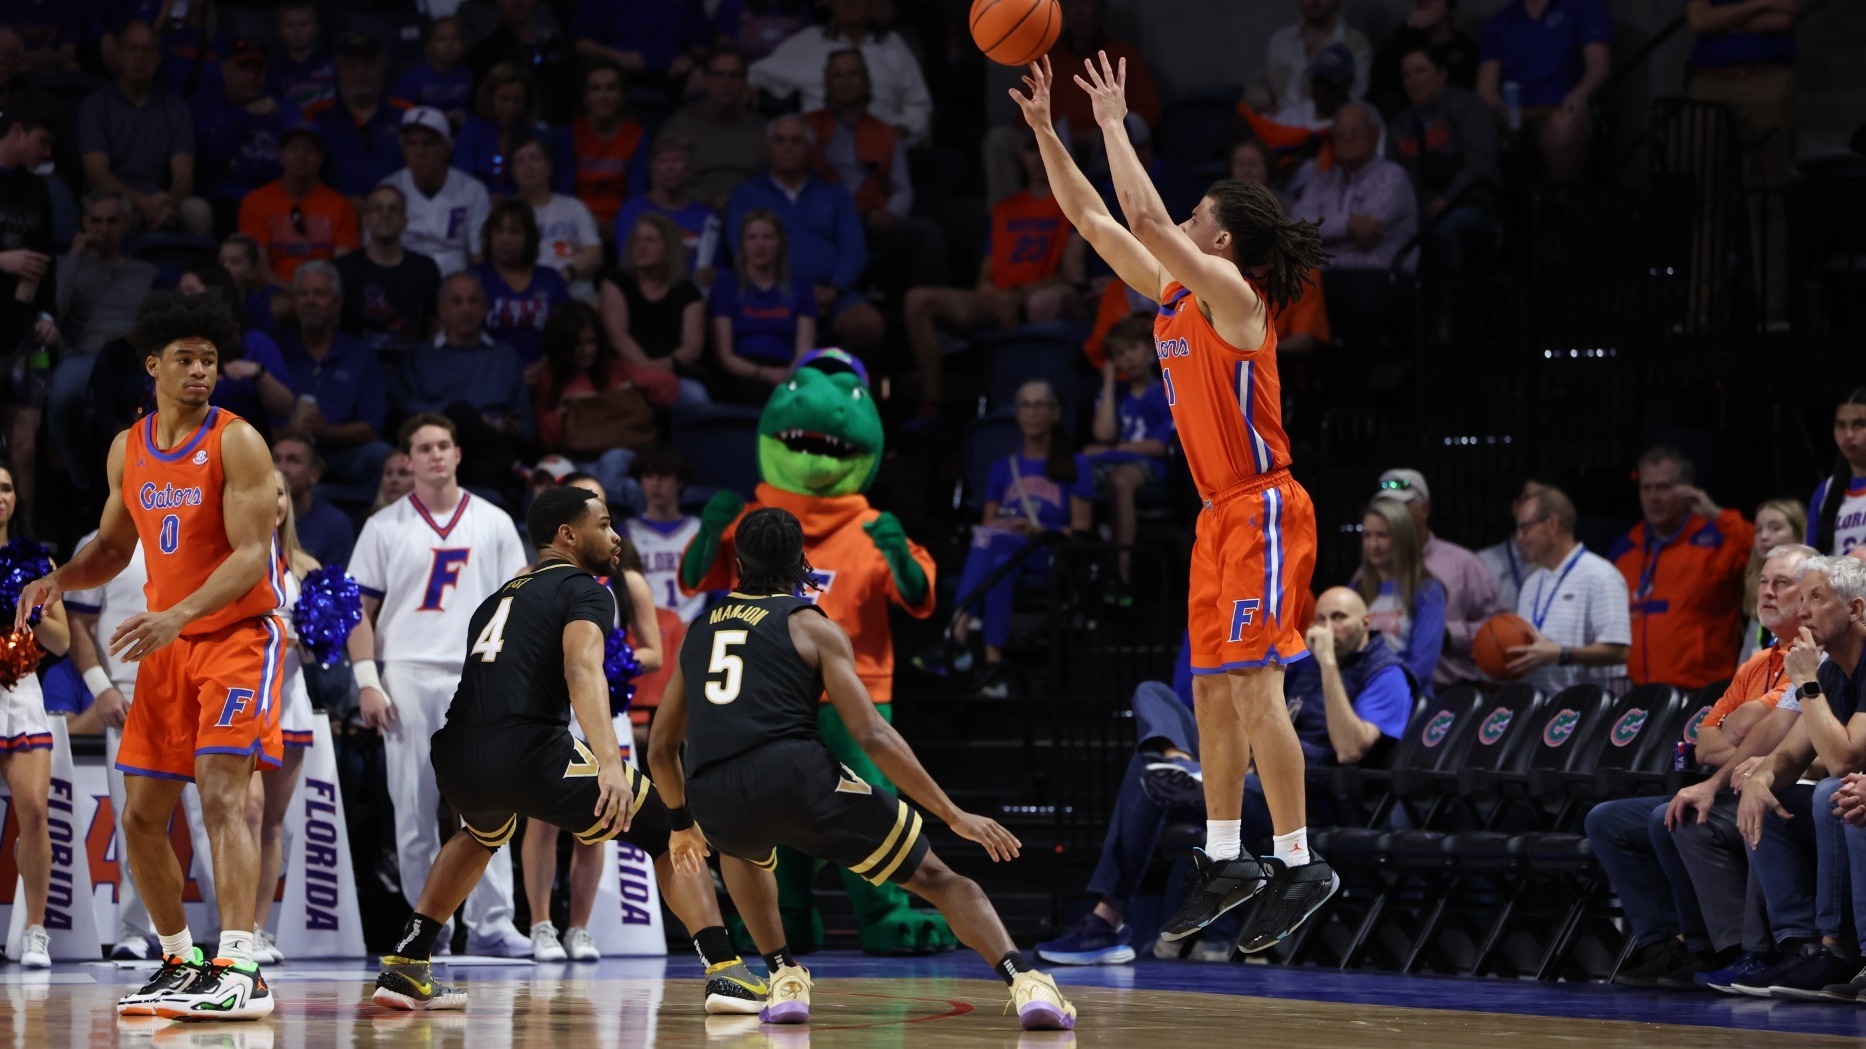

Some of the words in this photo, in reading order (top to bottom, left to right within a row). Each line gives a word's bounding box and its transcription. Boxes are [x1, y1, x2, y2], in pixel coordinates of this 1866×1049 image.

[447, 207, 467, 239] F
[1163, 367, 1176, 407] 1
[140, 482, 202, 510] Gators
[160, 514, 180, 554] 0
[415, 547, 471, 613] F
[665, 579, 678, 607] 1
[470, 596, 514, 663] 4
[709, 604, 770, 627] MANJON
[1227, 598, 1261, 643] F
[704, 630, 749, 705] 5
[214, 687, 255, 727] F
[305, 777, 339, 932] FLORIDA
